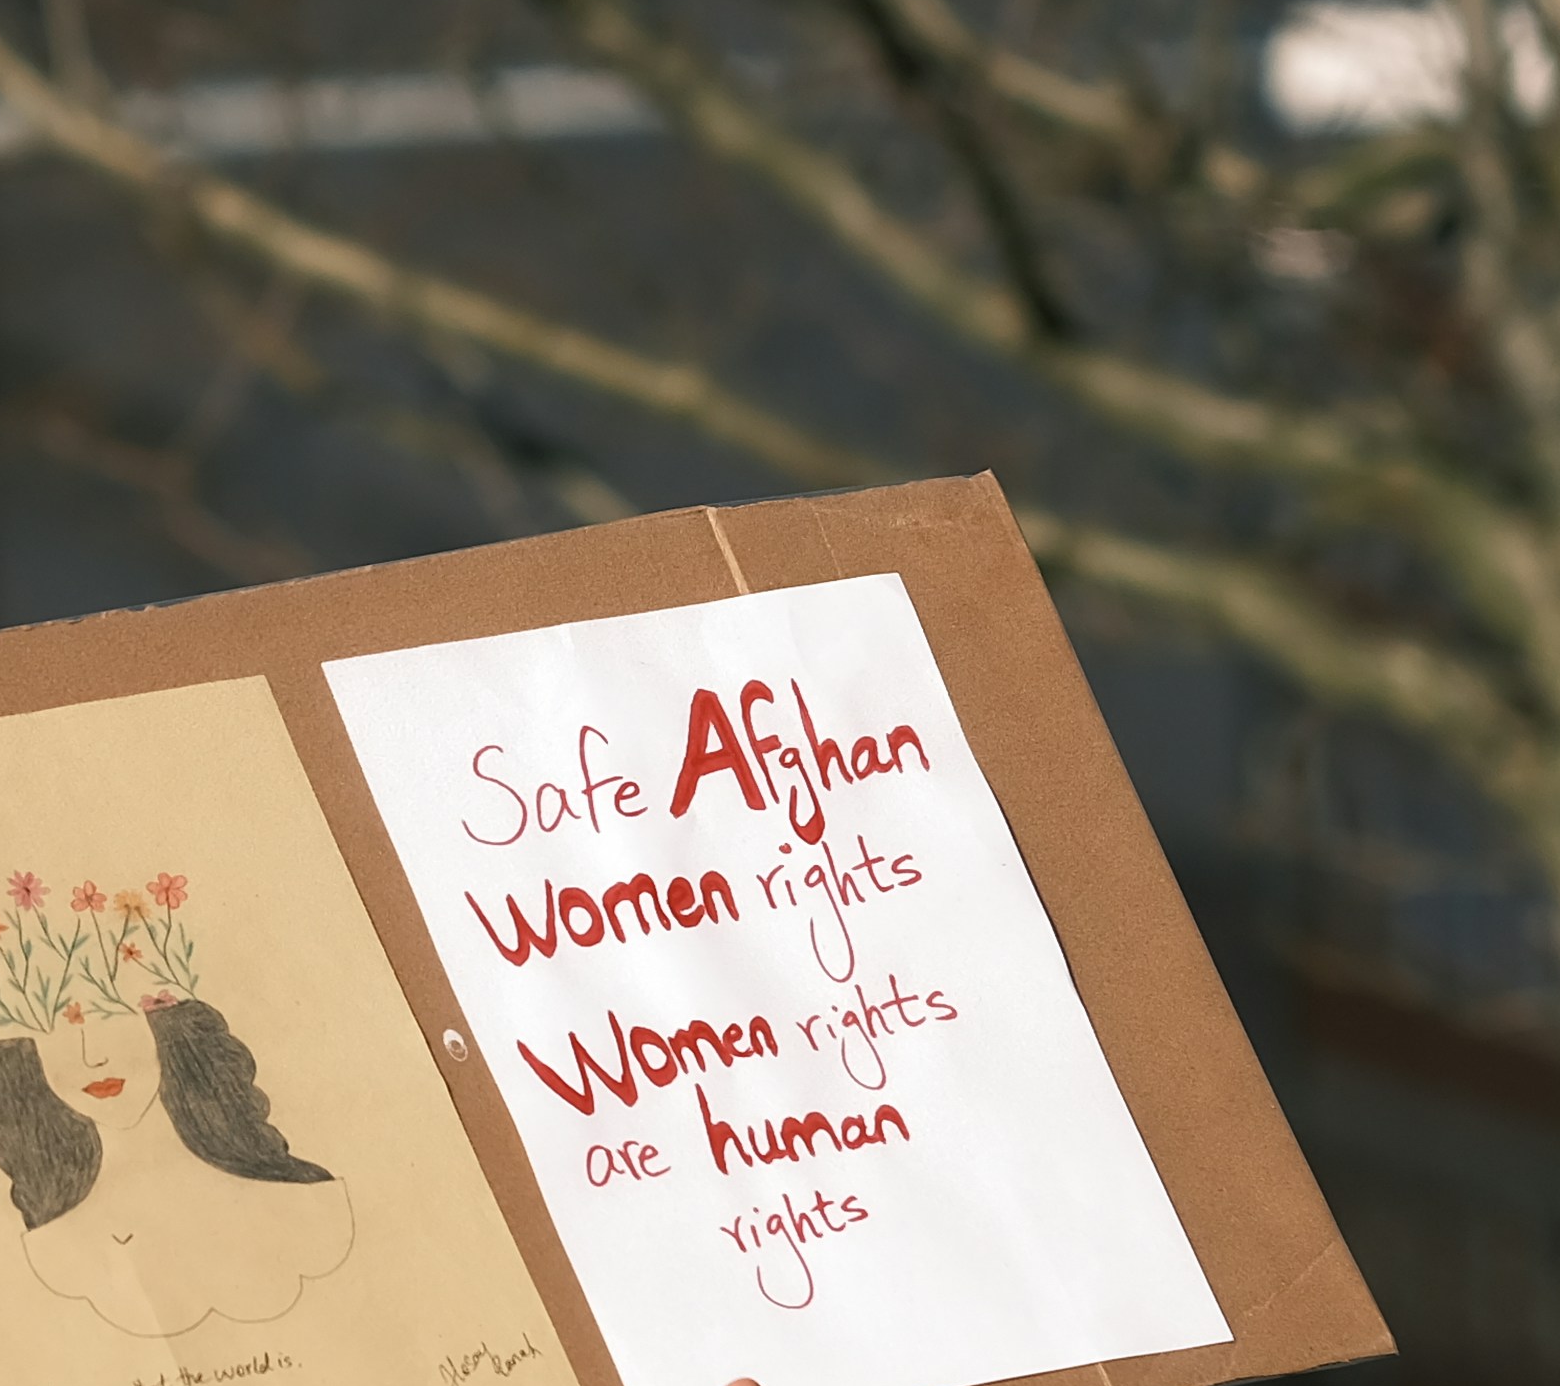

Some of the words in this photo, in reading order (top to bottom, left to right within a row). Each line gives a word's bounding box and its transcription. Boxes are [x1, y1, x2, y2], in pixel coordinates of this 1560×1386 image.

[461, 725, 648, 846] Safe
[670, 678, 930, 844] Afghan
[464, 868, 739, 967] Women
[756, 835, 922, 982] rights
[517, 1011, 777, 1116] Women
[797, 975, 957, 1090] rights
[585, 1138, 671, 1187] are
[696, 1084, 910, 1175] human
[720, 1190, 869, 1309] rights
[179, 1366, 202, 1386] the
[214, 1352, 271, 1381] world
